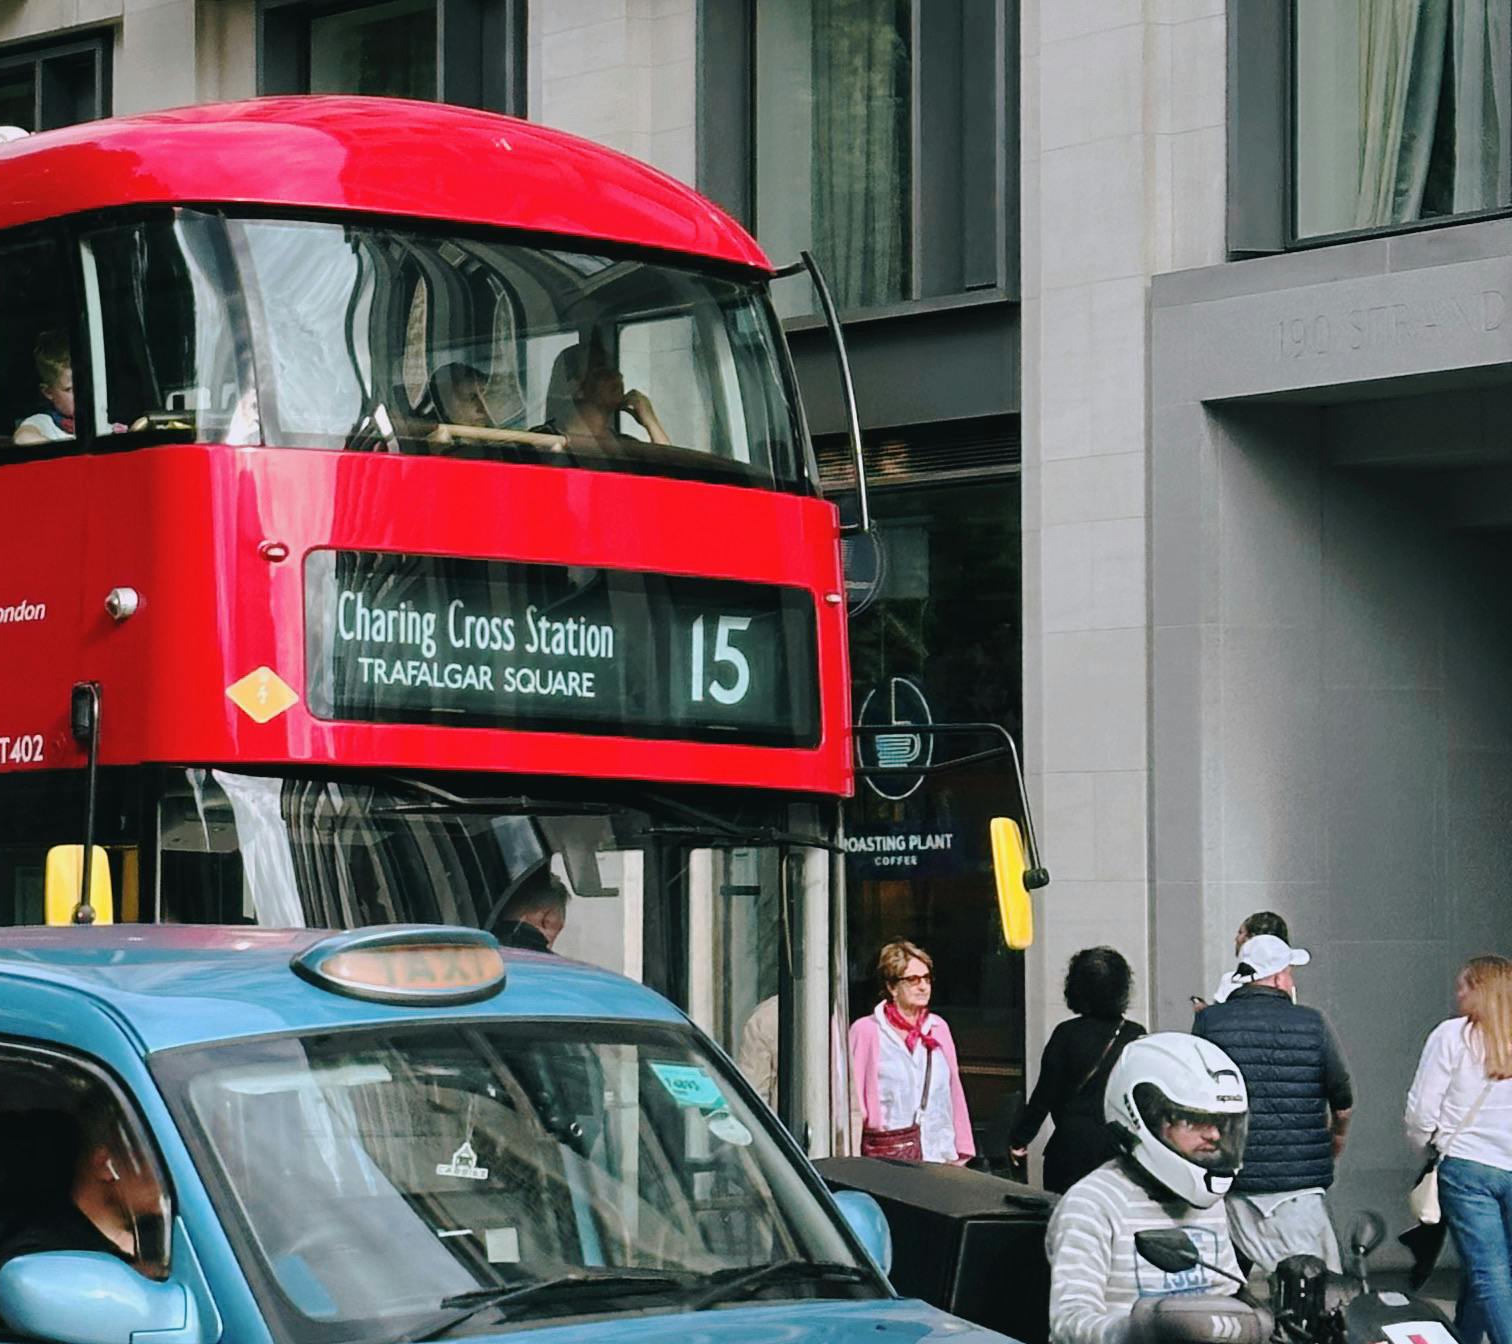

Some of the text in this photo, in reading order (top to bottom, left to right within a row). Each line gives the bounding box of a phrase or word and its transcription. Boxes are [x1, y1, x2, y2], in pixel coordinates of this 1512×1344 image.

[337, 591, 614, 659] Charing Cross Station
[358, 657, 595, 698] TRAFALGAR SQUARE
[691, 614, 752, 705] 15
[909, 833, 953, 851] PLANT
[376, 950, 486, 984] TAXI
